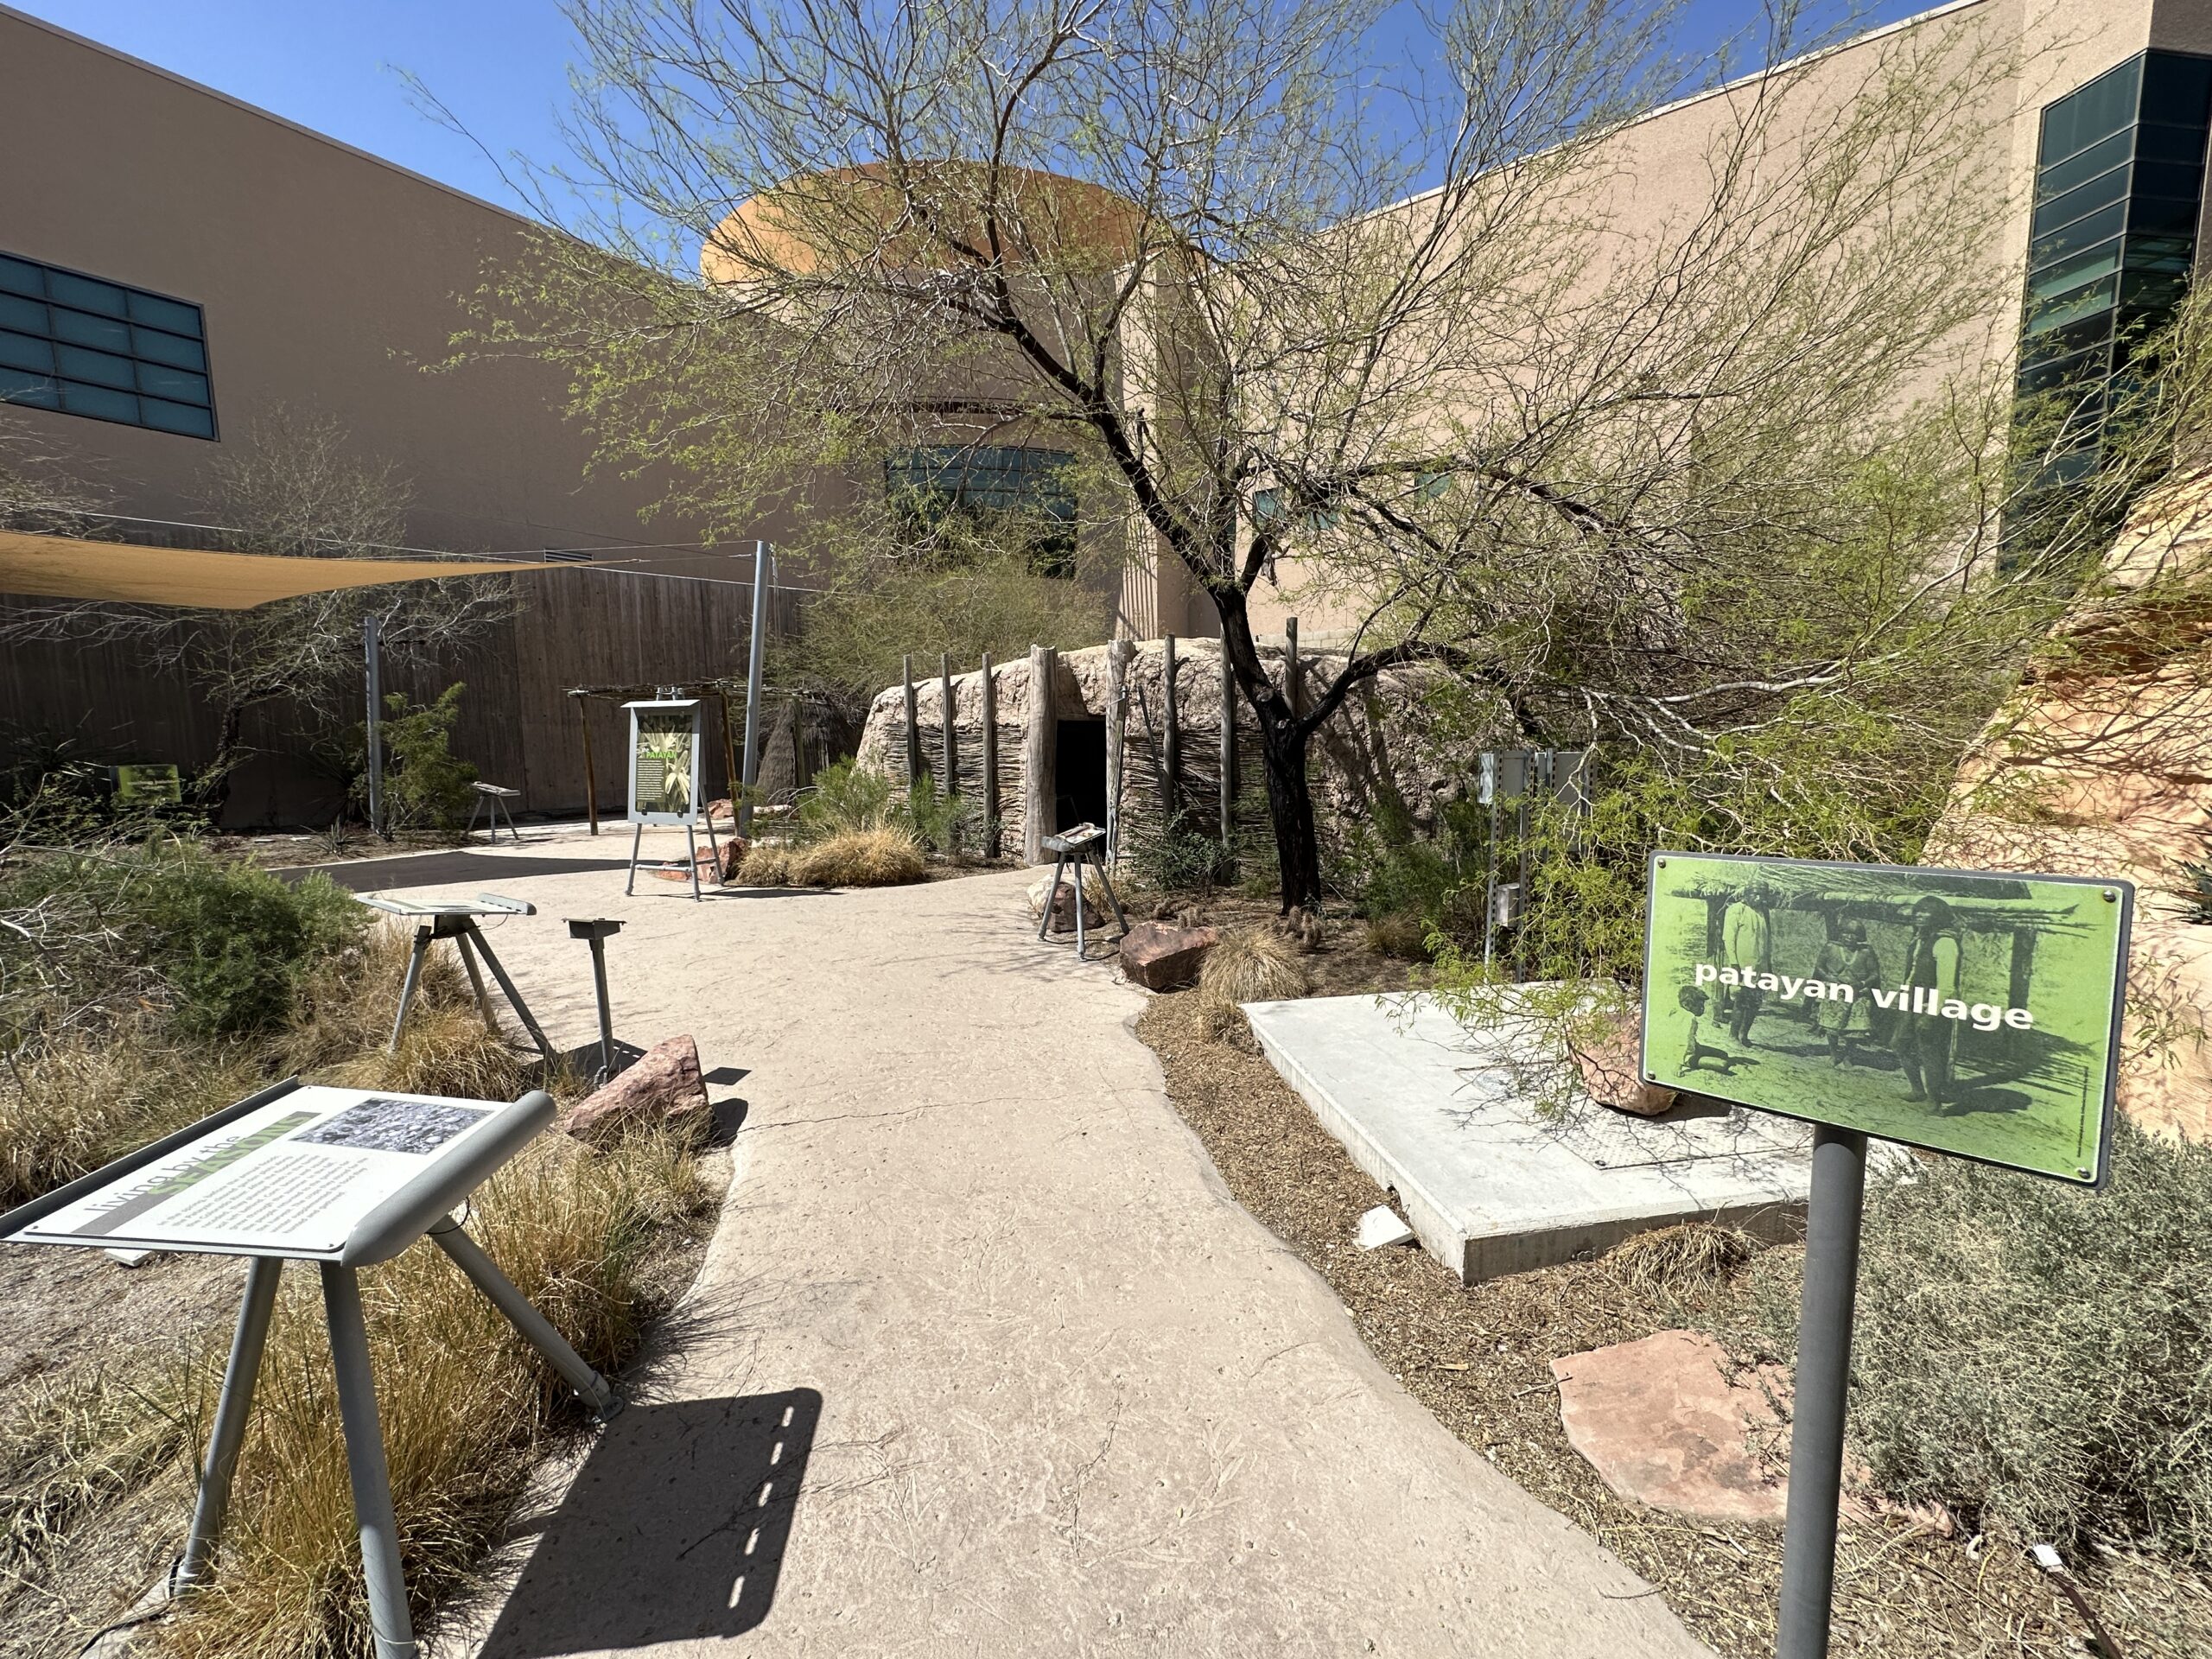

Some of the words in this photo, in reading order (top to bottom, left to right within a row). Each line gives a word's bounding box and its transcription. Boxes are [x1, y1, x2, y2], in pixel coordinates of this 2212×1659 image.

[1695, 963, 1855, 1003] patayan
[1871, 984, 2035, 1031] village
[84, 1174, 175, 1211] living
[161, 1156, 204, 1174] by
[200, 1135, 247, 1154] the
[148, 1116, 315, 1196] SEASONS
